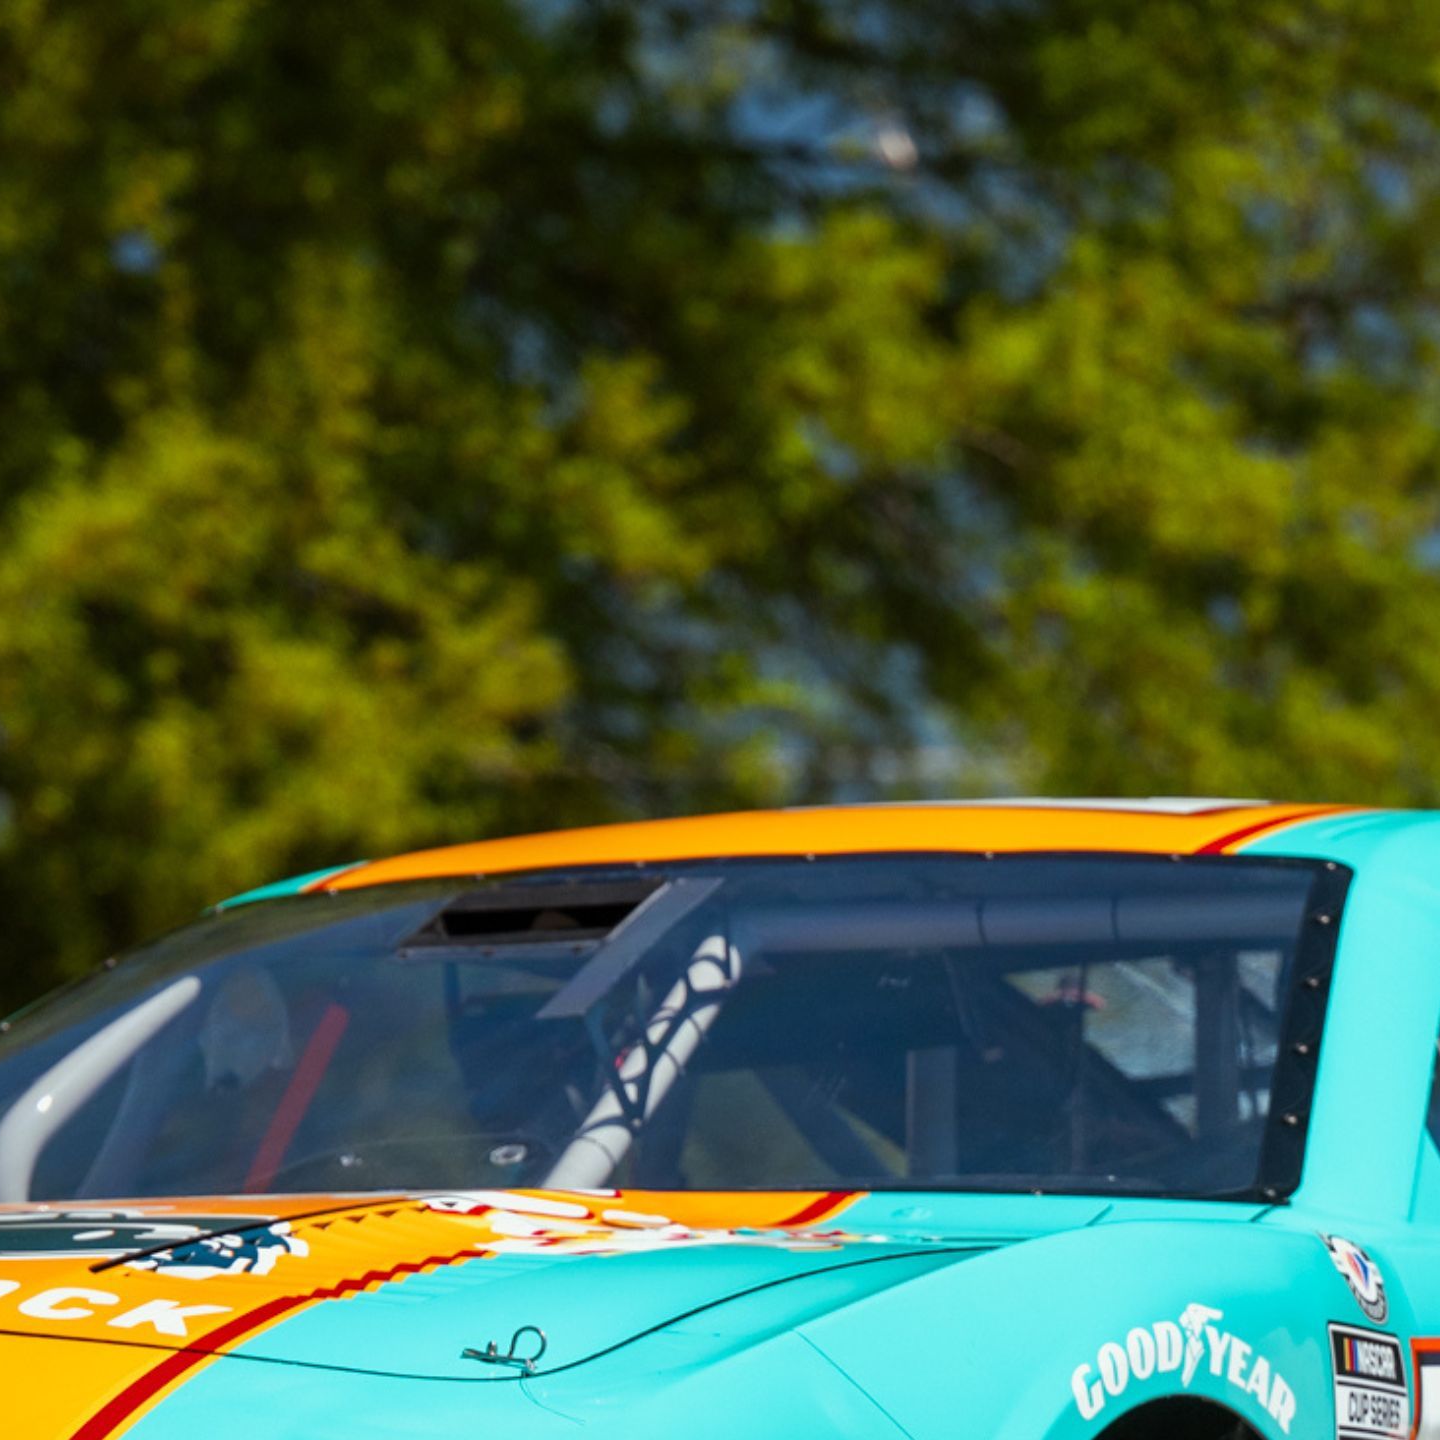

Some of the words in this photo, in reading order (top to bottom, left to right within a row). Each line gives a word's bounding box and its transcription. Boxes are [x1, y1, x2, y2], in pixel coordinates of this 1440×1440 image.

[1071, 1303, 1297, 1435] GOODYEAR
[1356, 1338, 1398, 1380] NASCAR
[1348, 1391, 1369, 1424] CUP
[1369, 1393, 1401, 1430] SERIES
